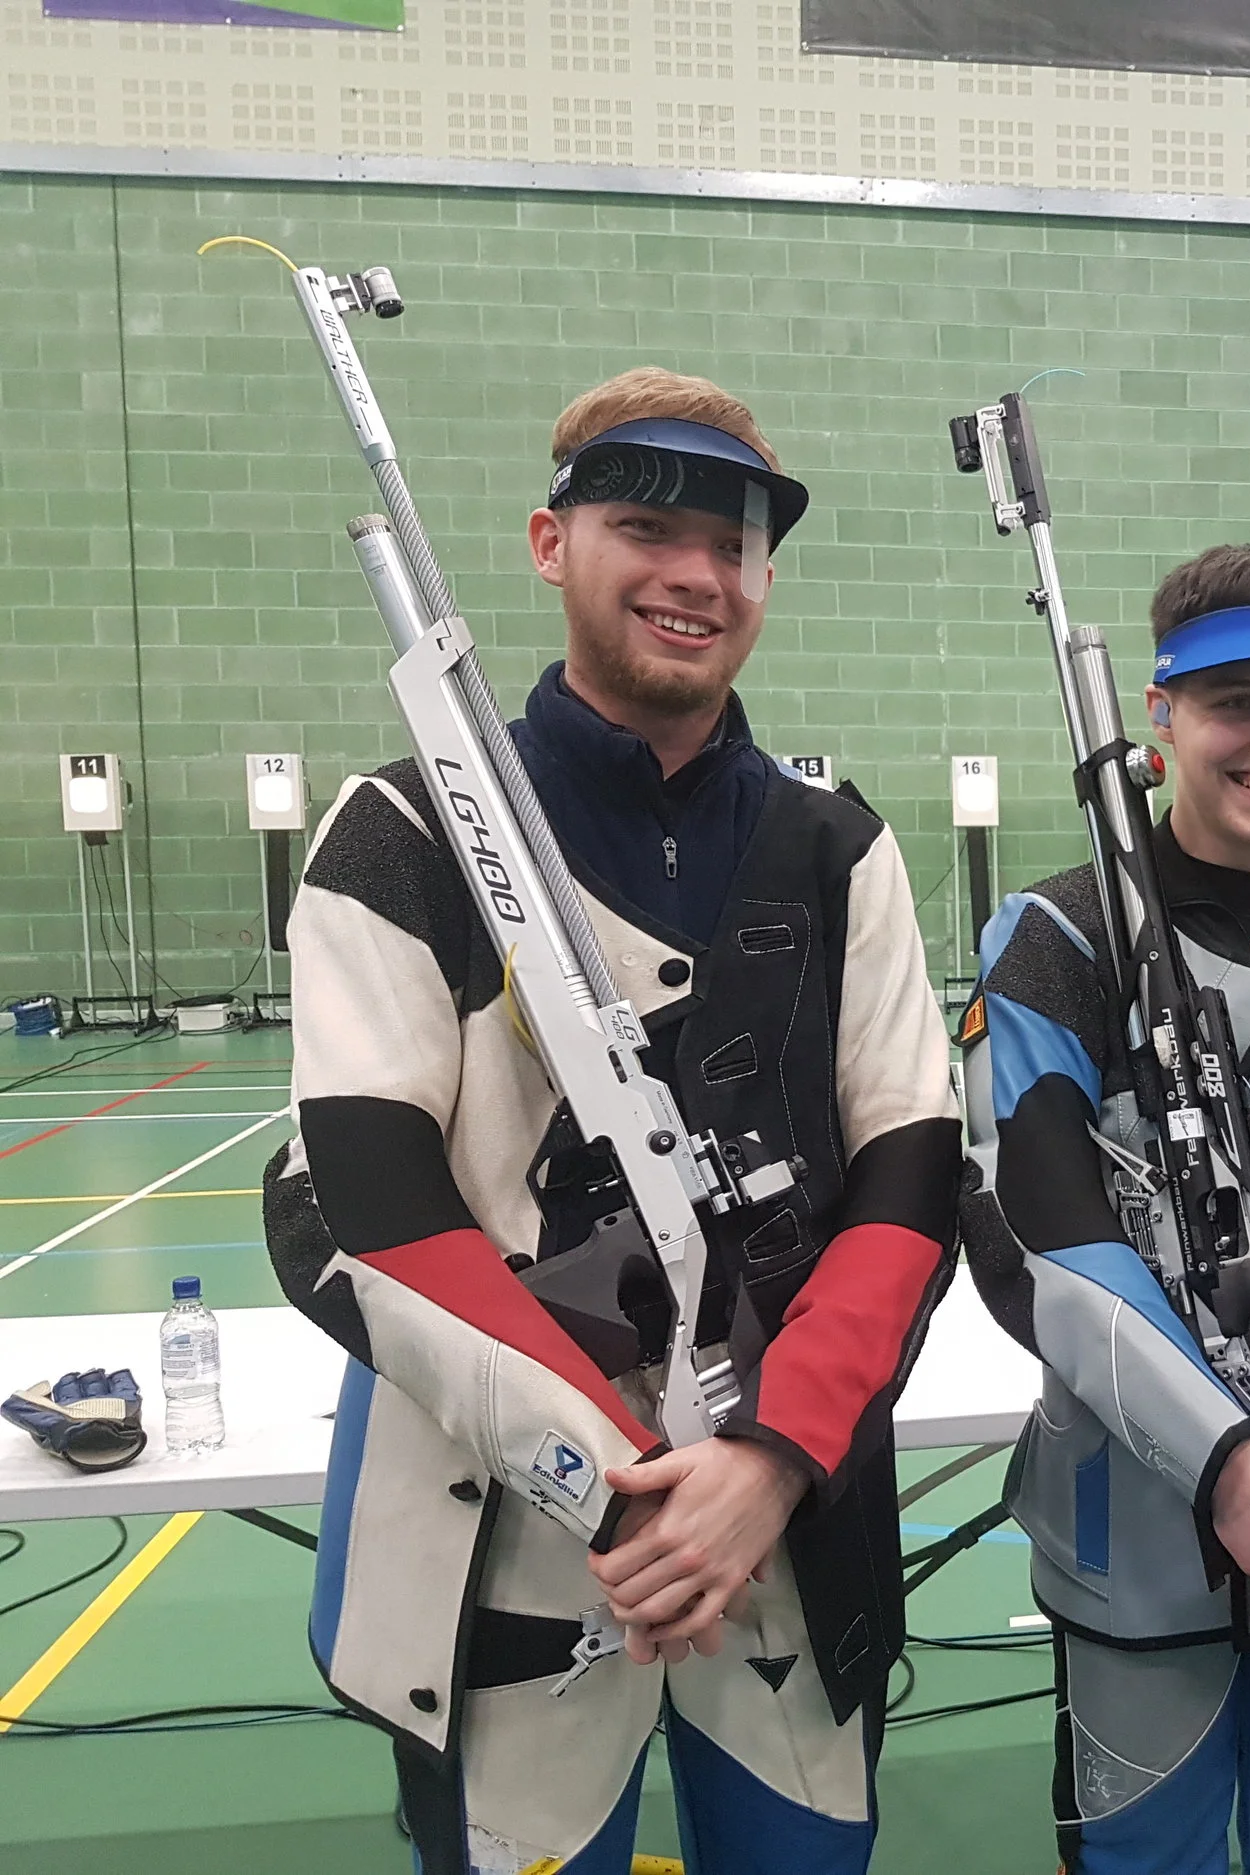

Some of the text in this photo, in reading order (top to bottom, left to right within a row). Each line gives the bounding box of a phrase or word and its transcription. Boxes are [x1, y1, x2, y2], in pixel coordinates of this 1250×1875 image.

[320, 308, 368, 405] WALTHER
[77, 759, 98, 775] 11
[263, 758, 285, 774] 12
[798, 759, 819, 775] 15
[962, 761, 981, 775] 16
[615, 1008, 641, 1043] LG
[1201, 1053, 1227, 1098] 800
[532, 1463, 579, 1500] Edinkillie
